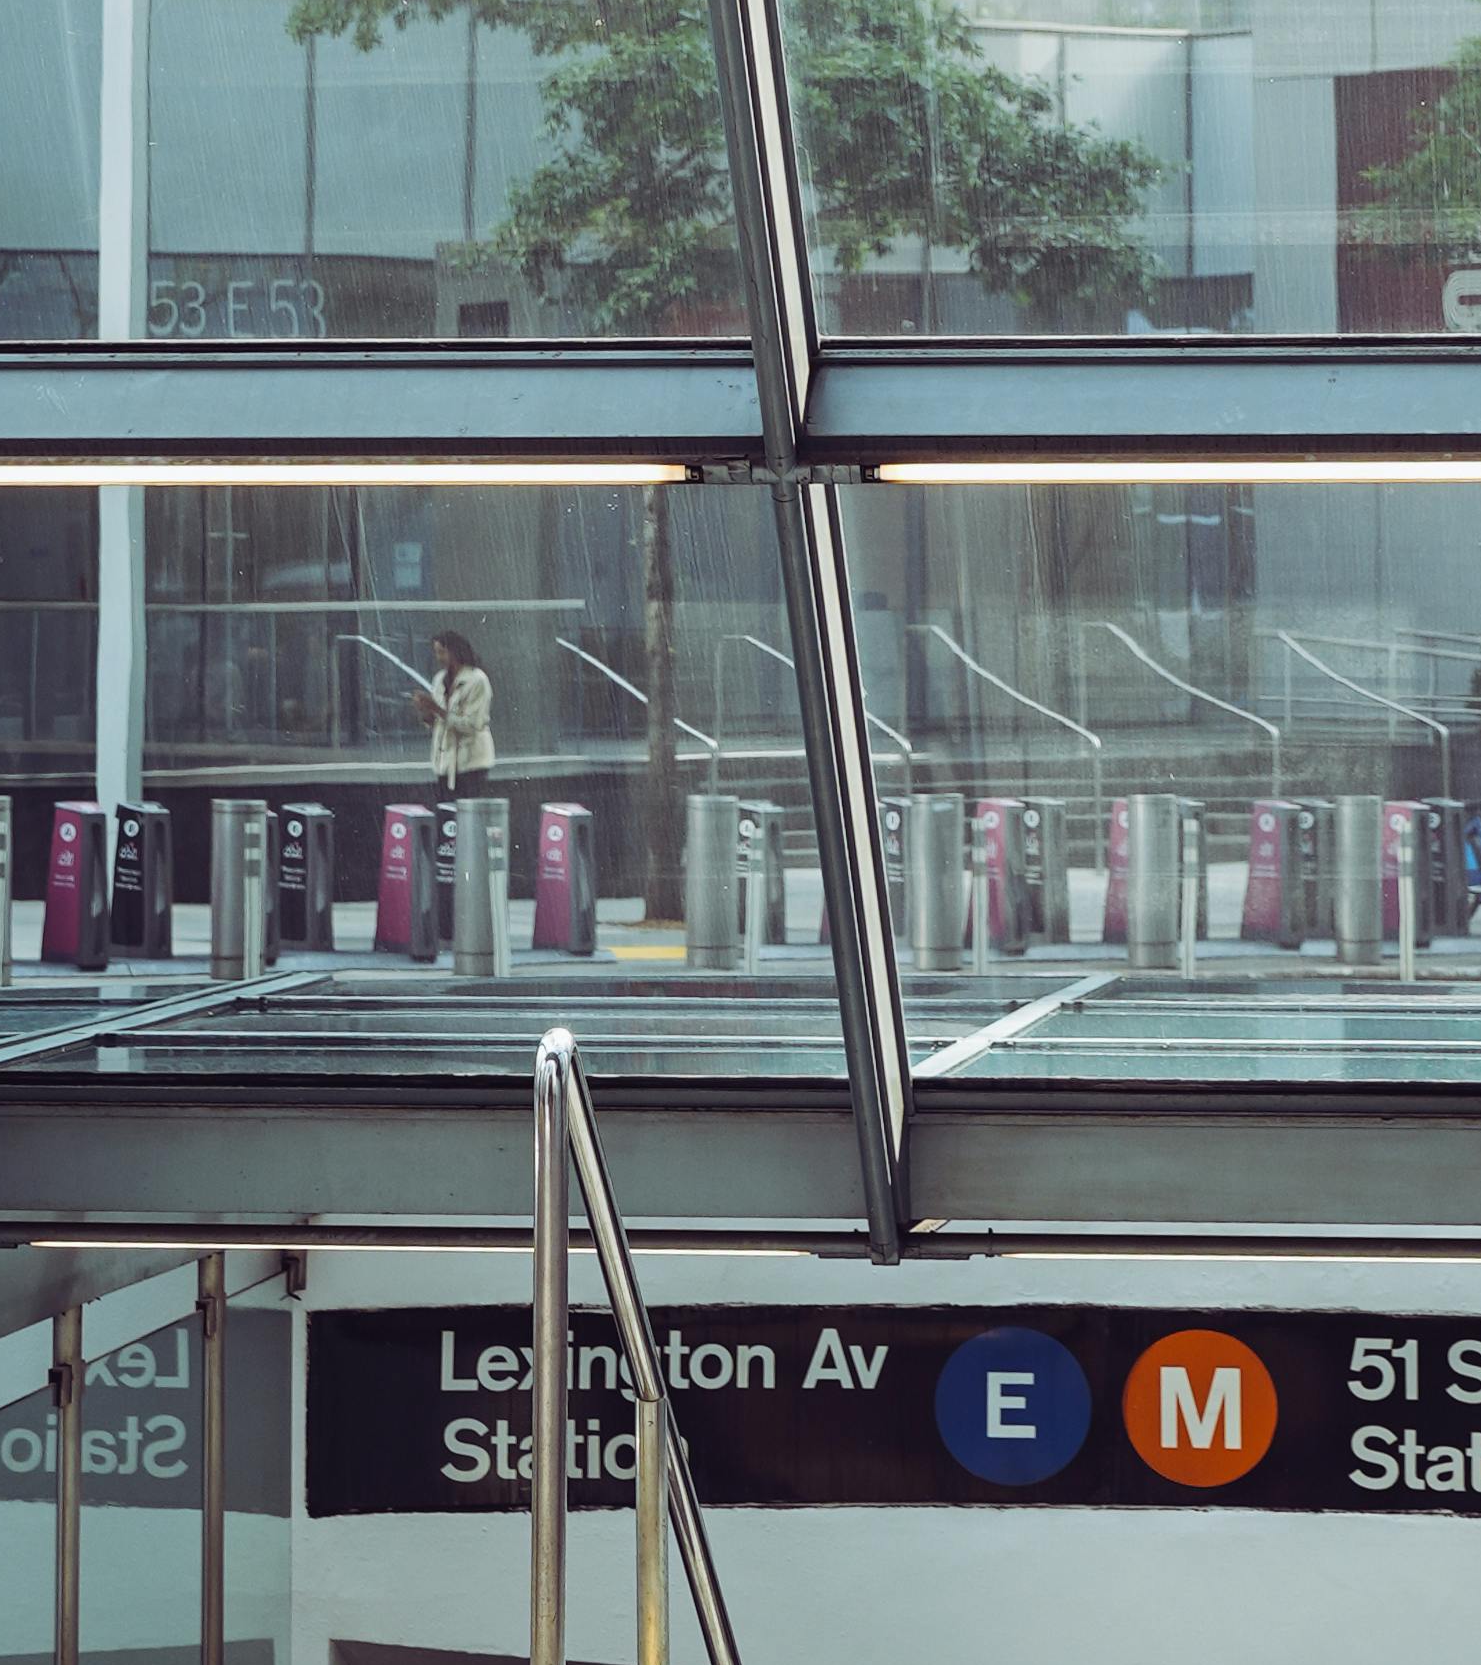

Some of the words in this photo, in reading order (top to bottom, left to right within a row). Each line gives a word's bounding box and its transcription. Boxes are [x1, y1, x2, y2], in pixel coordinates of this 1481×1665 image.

[440, 1330, 775, 1403] Leinton
[802, 1328, 889, 1389] Av
[1347, 1337, 1419, 1401] 51
[986, 1371, 1036, 1439] E
[1159, 1365, 1243, 1451] M
[439, 1417, 690, 1484] Sttio
